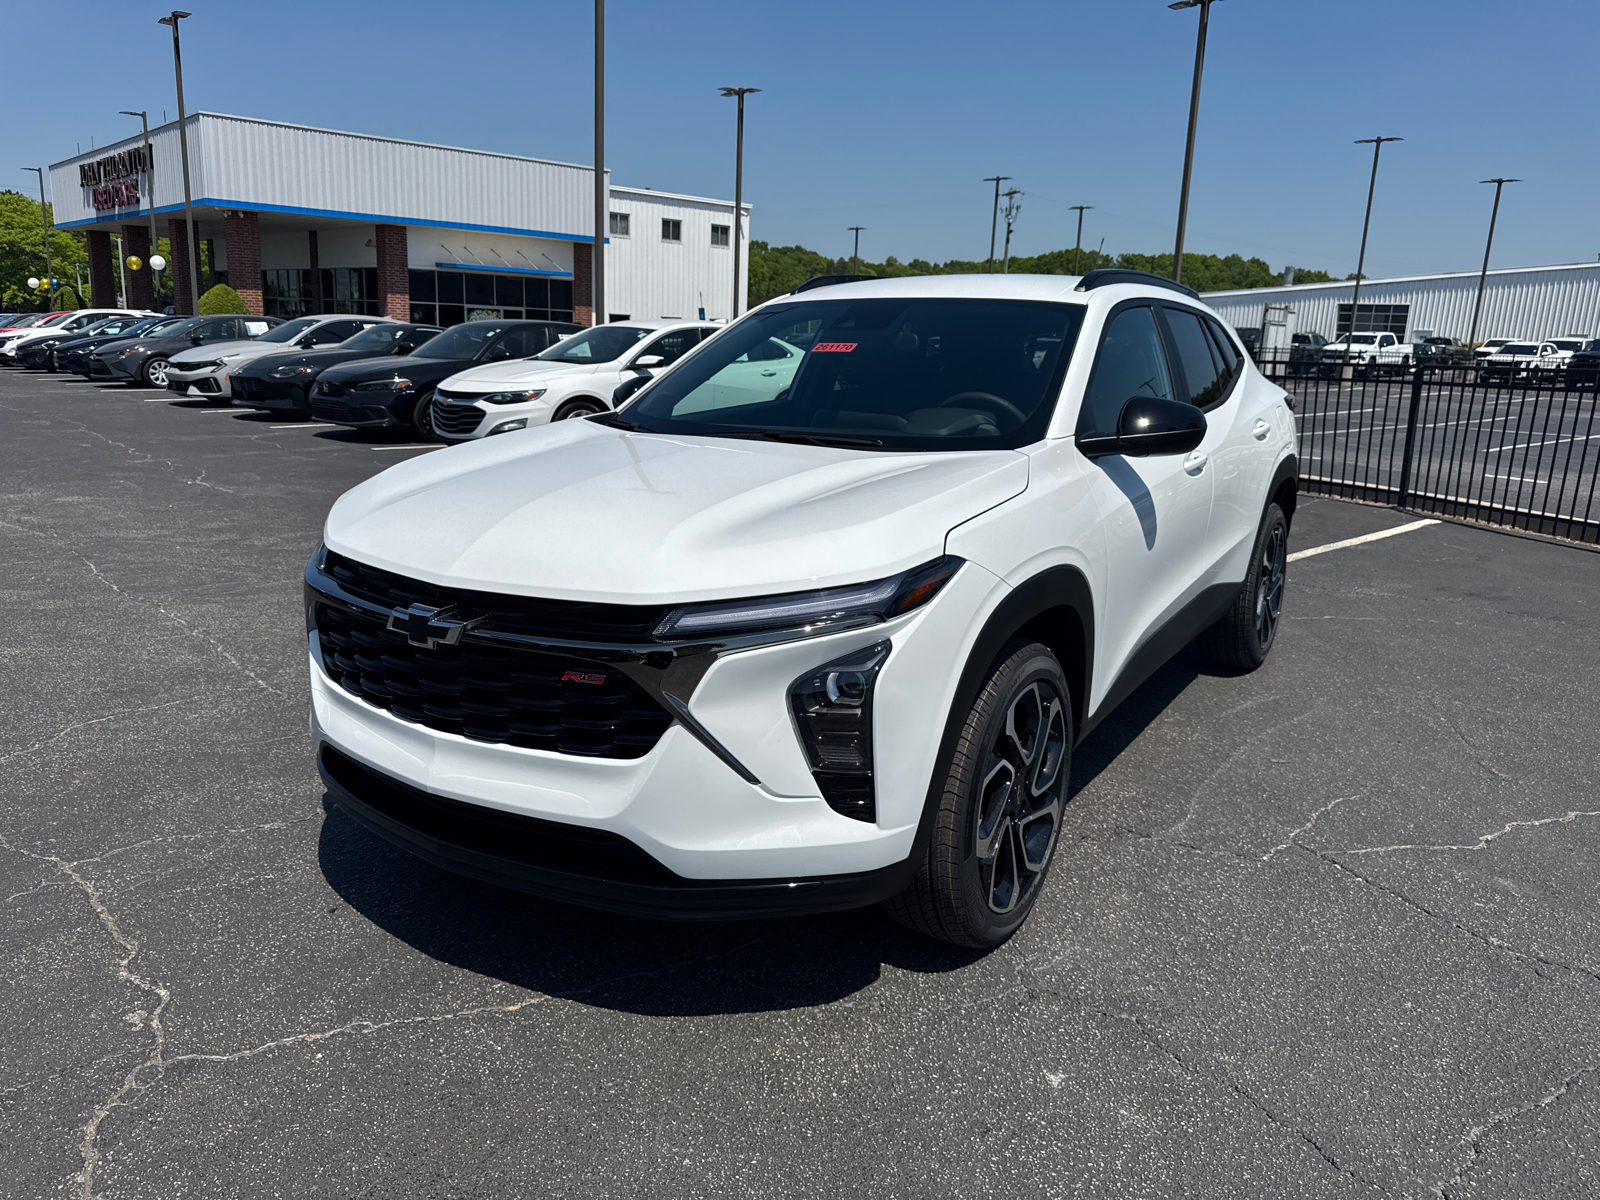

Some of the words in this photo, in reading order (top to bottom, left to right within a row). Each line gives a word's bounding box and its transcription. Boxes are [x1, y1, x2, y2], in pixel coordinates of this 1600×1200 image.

[79, 160, 103, 187] JOHN
[93, 184, 115, 211] USED
[114, 178, 139, 207] CARS
[814, 343, 854, 351] 261170
[561, 671, 607, 685] RS
